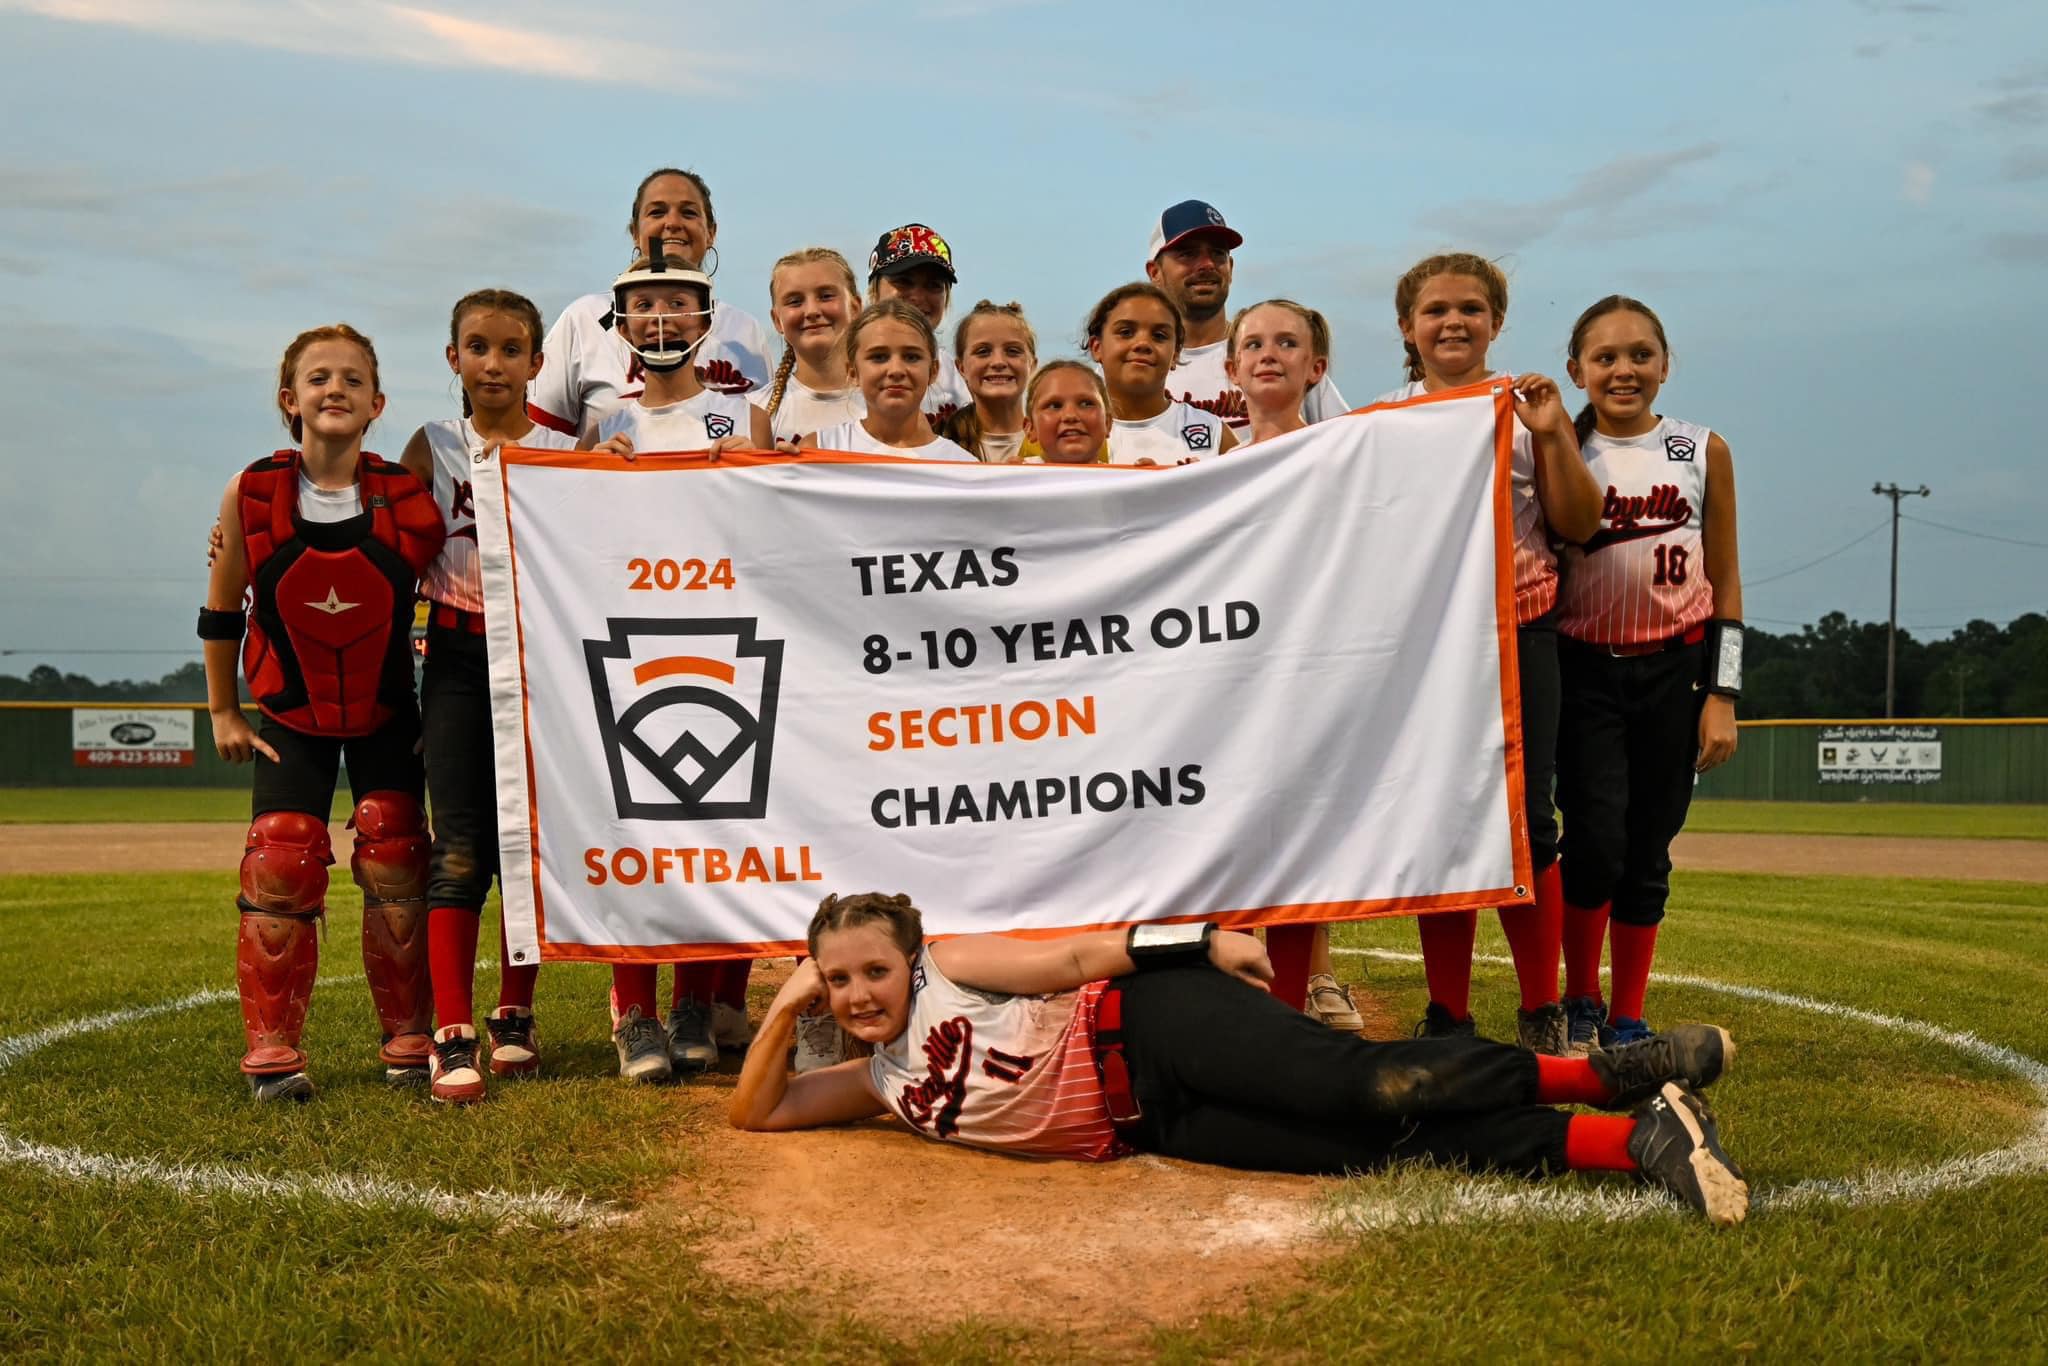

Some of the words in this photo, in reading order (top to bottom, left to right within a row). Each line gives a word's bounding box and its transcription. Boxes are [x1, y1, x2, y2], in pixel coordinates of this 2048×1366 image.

[911, 226, 939, 253] K
[1600, 484, 1693, 529] byville
[627, 558, 737, 592] 2024
[851, 546, 1019, 596] TEXAS
[1652, 543, 1689, 586] 10
[863, 627, 978, 675] 8-10
[990, 614, 1135, 664] YEAR
[1150, 600, 1260, 649] OLD
[867, 695, 1097, 752] SECTION
[871, 763, 1206, 829] CHAMPIONS
[583, 845, 823, 887] SOFTBALL
[982, 1047, 1035, 1084] 11
